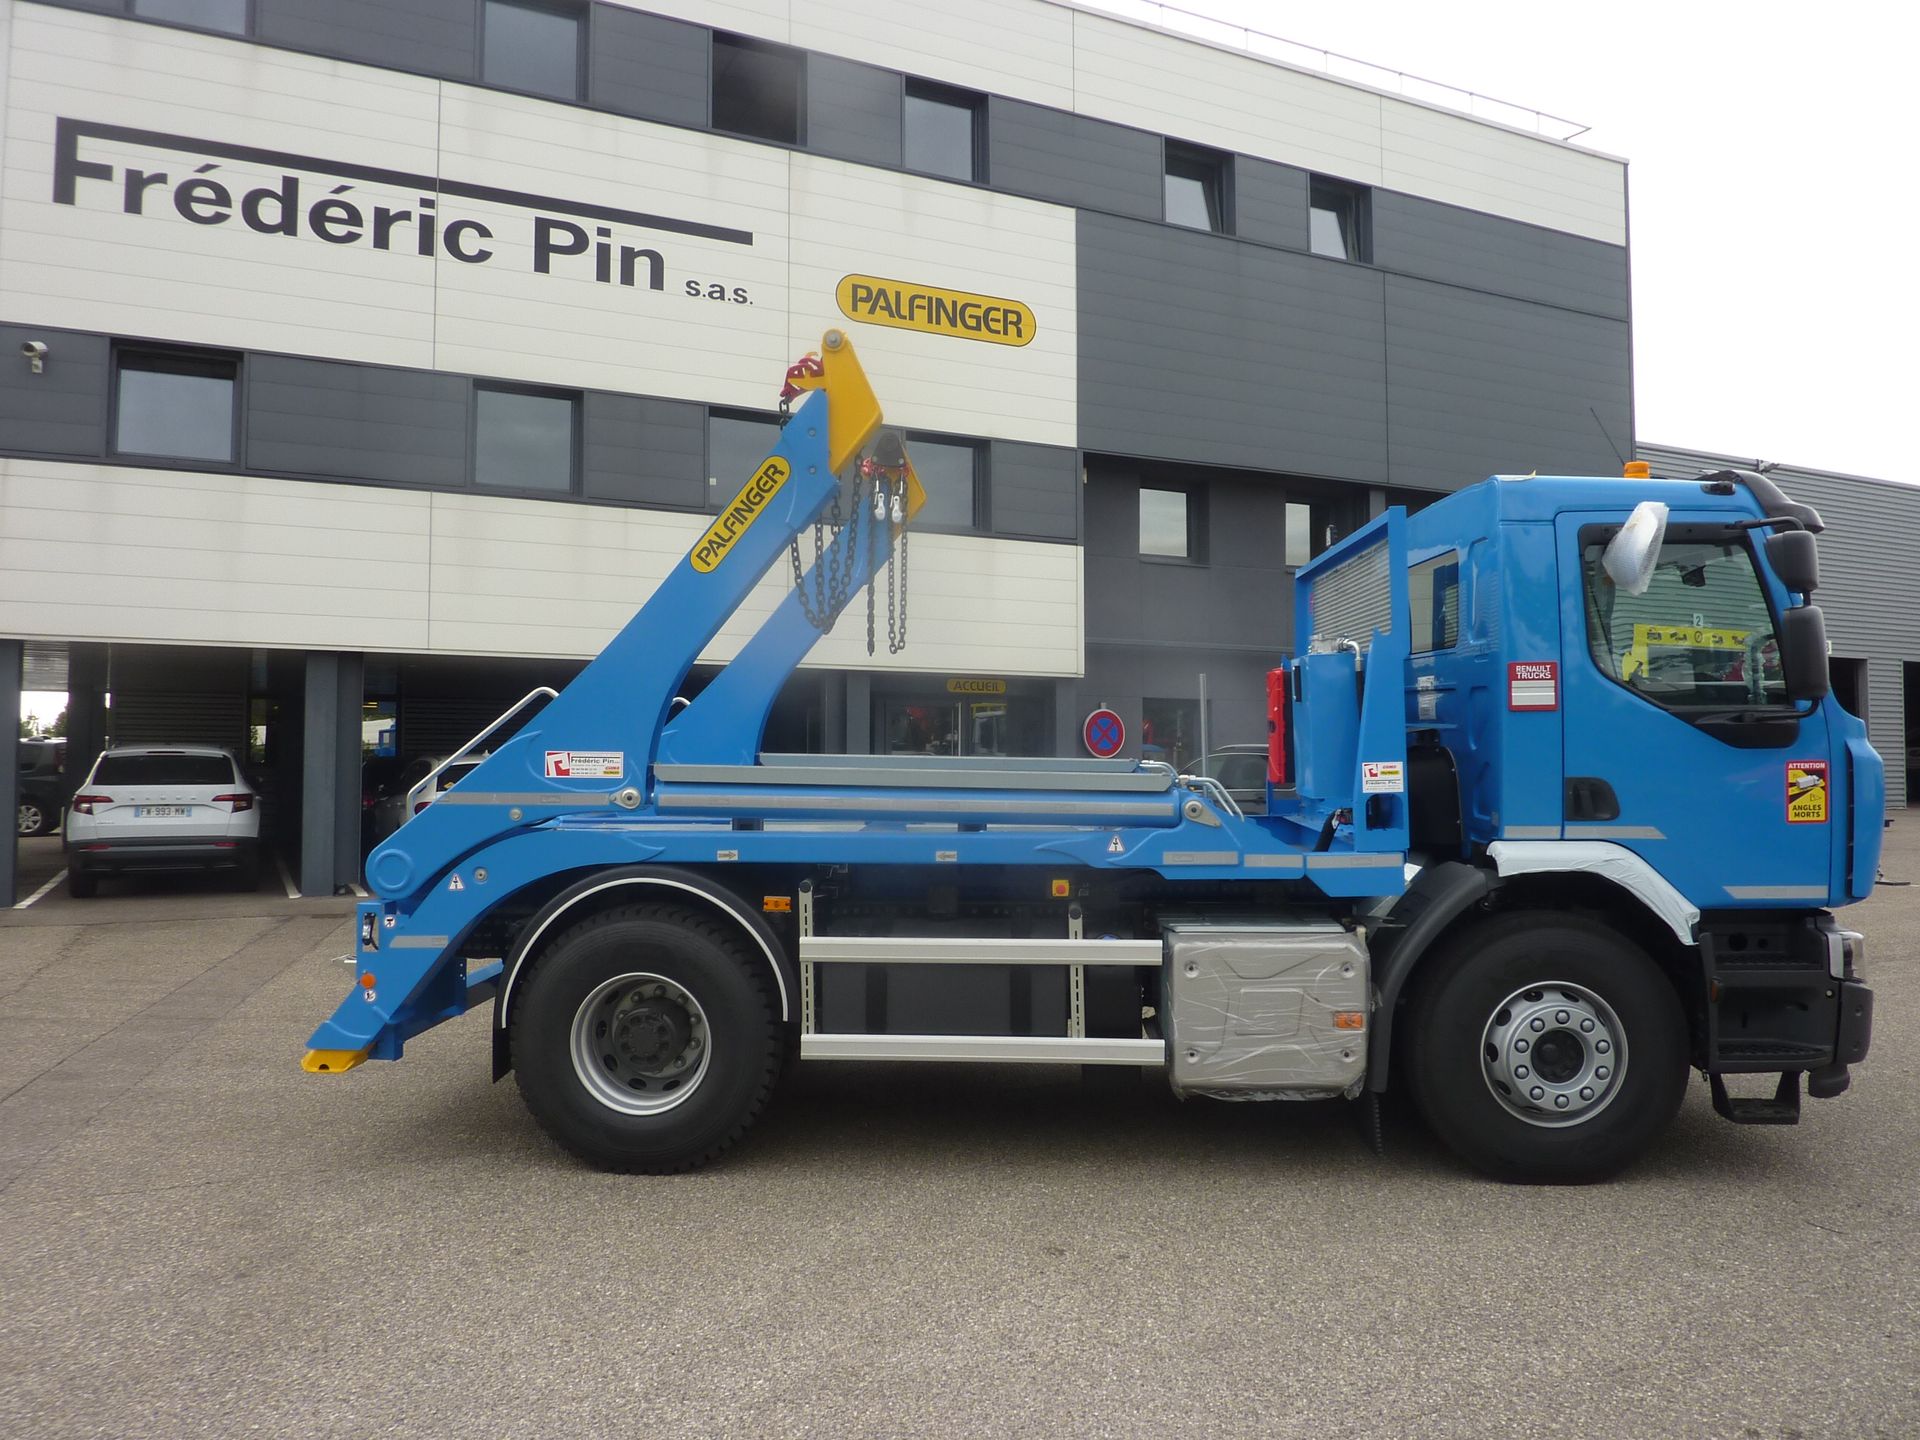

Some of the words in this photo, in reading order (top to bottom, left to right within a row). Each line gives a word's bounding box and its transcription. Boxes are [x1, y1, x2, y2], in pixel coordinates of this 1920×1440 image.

[52, 116, 494, 264] Frédéric
[533, 215, 665, 292] Pin
[684, 278, 754, 305] s.a.s.
[851, 282, 1024, 339] PALFINGER
[694, 462, 786, 567] PALFINGER
[952, 679, 1000, 692] ACCUEIL
[1515, 664, 1551, 673] RENAULT
